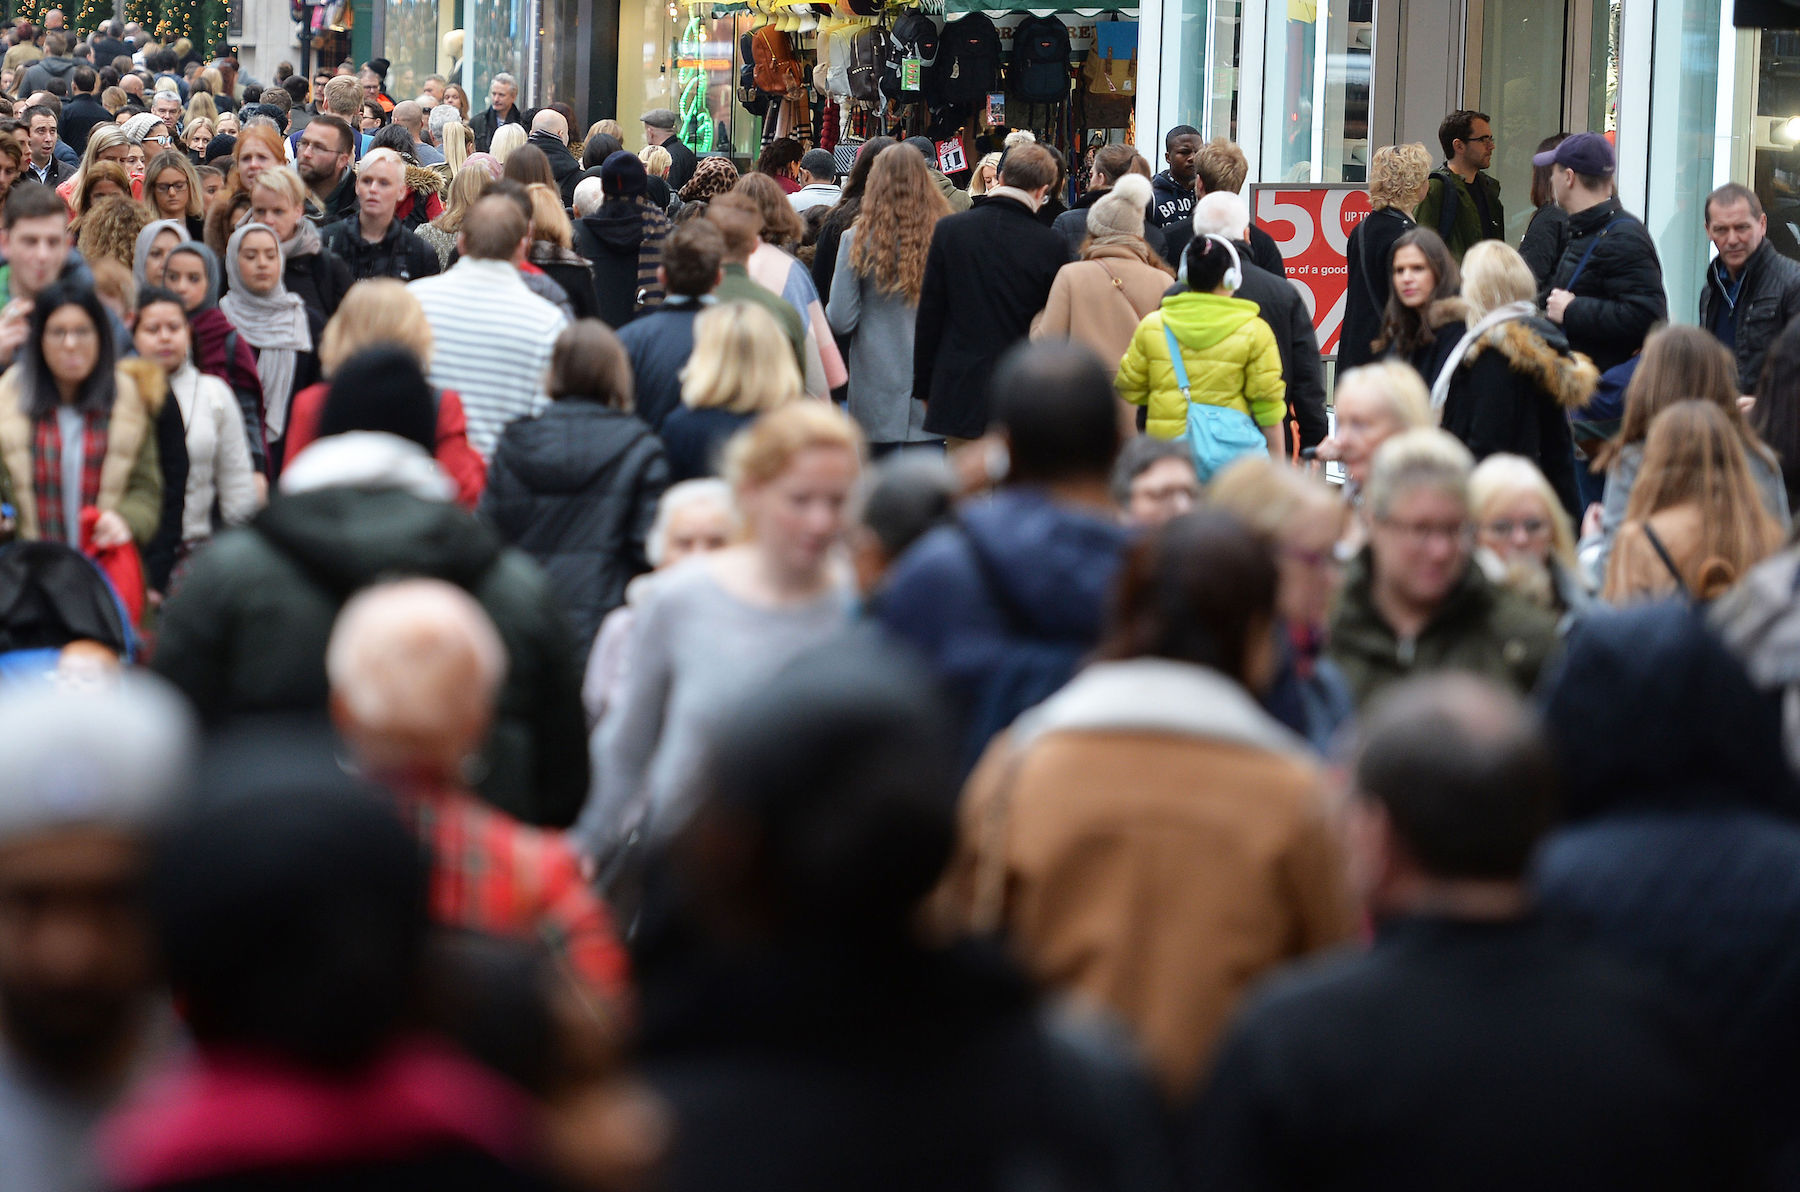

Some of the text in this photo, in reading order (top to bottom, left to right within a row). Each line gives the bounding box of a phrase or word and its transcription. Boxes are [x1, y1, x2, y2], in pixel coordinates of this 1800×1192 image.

[1344, 211, 1357, 222] UP
[1298, 264, 1309, 274] of
[1311, 266, 1319, 274] a
[1320, 264, 1348, 276] good
